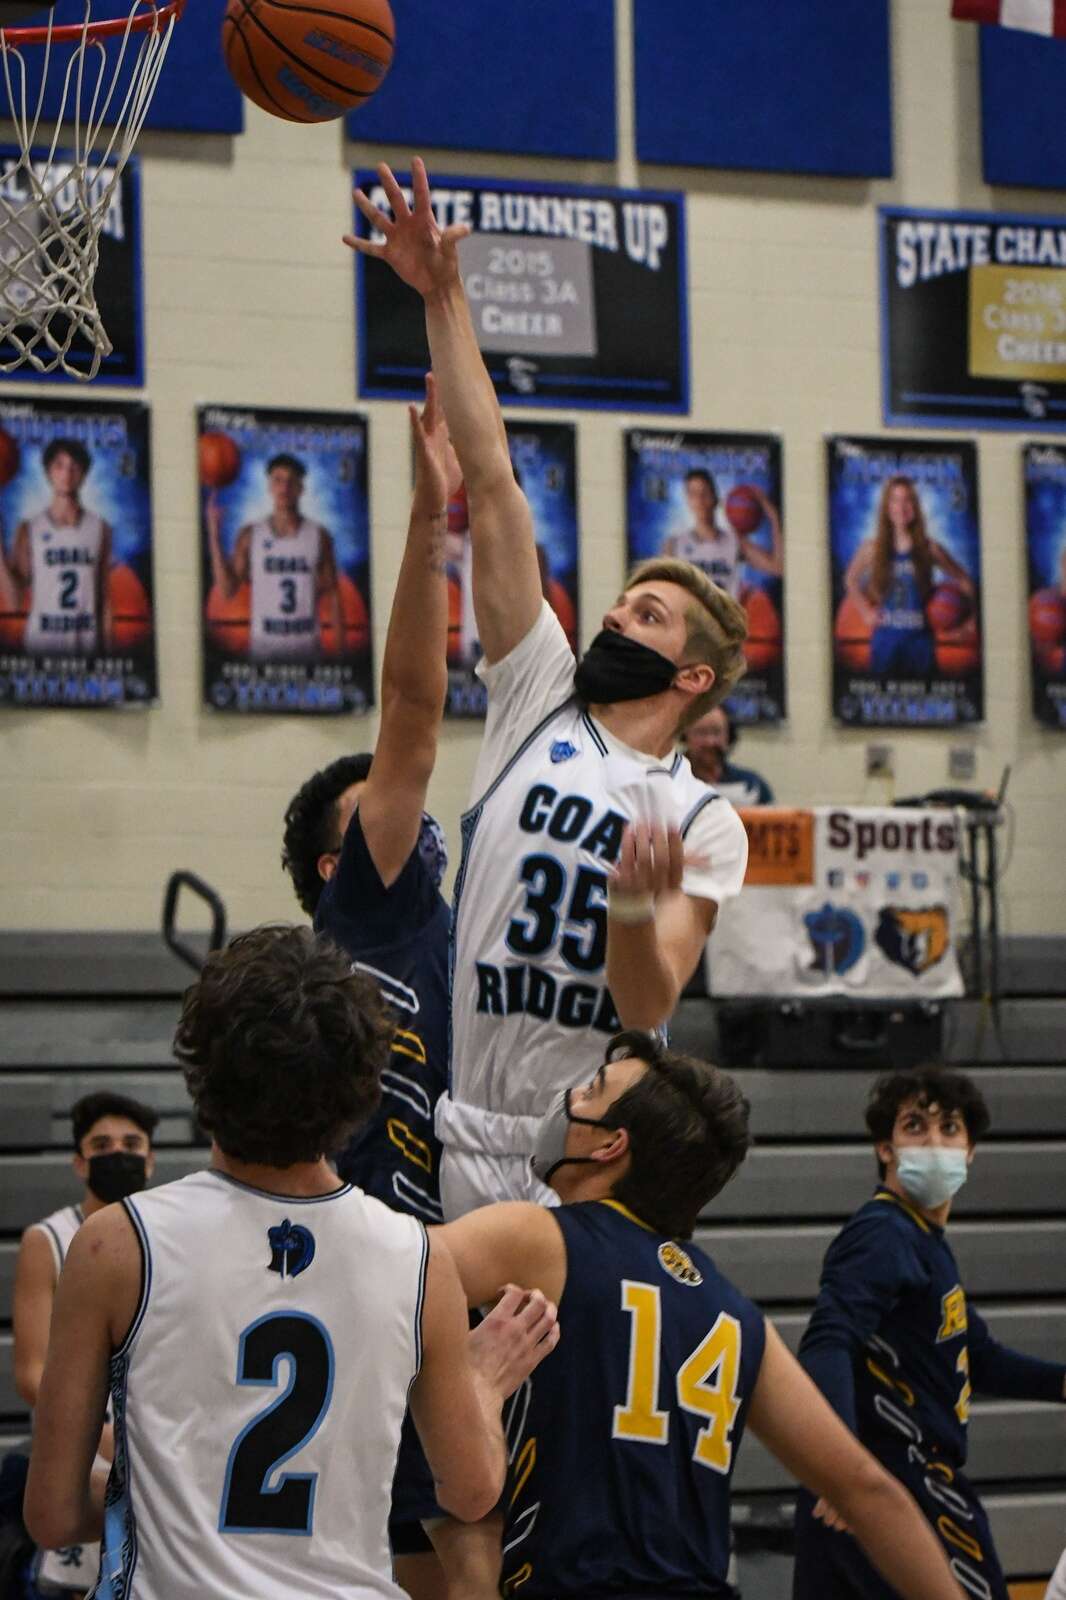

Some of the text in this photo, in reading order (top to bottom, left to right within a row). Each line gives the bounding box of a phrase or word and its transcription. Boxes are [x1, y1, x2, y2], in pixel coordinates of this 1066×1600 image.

[370, 186, 667, 271] STE RUNNER UP
[487, 247, 555, 276] 2015
[897, 220, 1066, 288] STATE CHA
[60, 570, 79, 610] 2
[280, 579, 297, 614] 3
[519, 784, 630, 862] COA
[829, 809, 957, 859] Sports
[505, 852, 610, 976] 35
[611, 1279, 743, 1475] 14
[218, 1309, 336, 1537] 2
